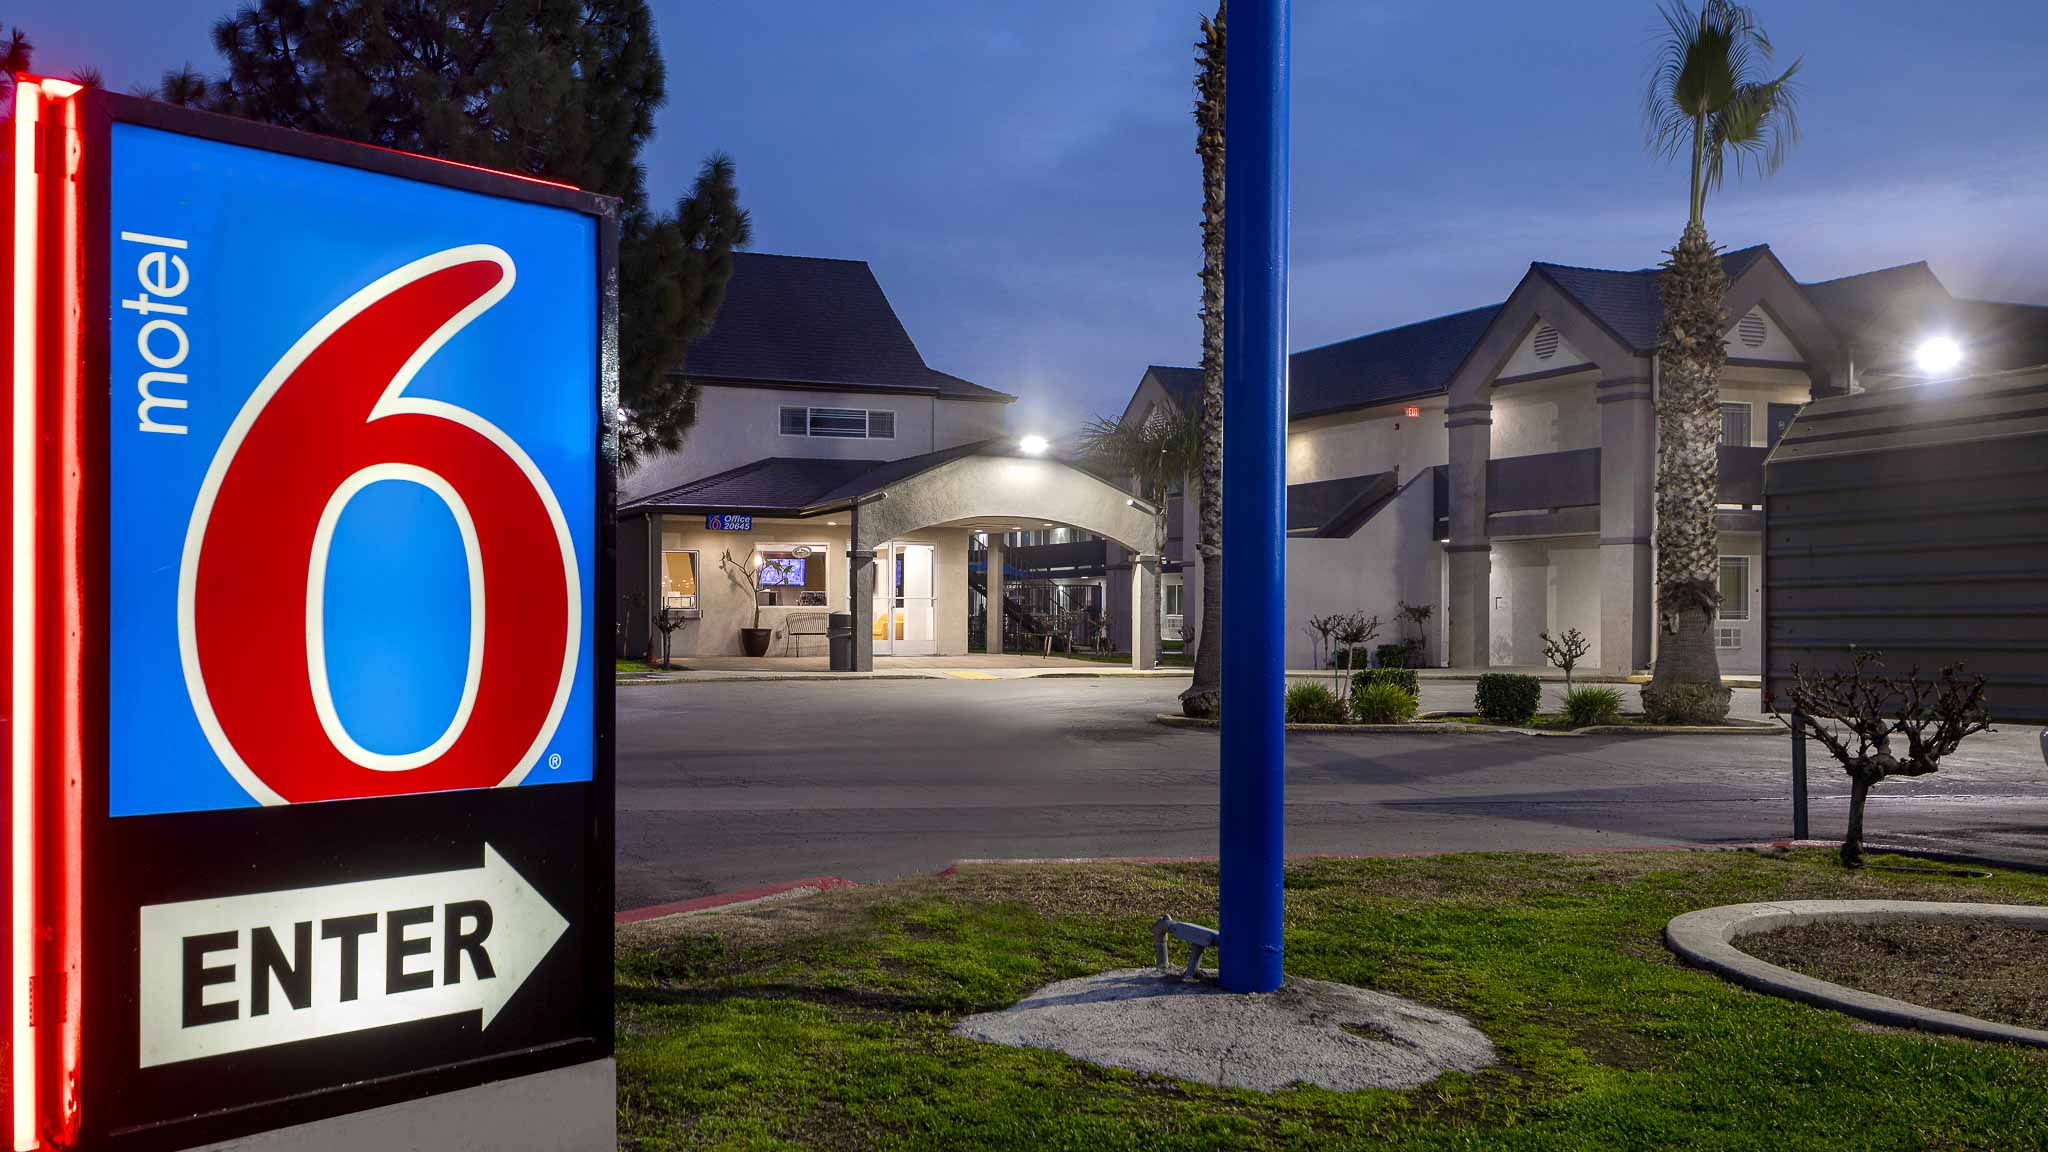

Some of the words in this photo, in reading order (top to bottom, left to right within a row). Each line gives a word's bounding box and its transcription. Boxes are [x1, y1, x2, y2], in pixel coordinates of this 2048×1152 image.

[121, 231, 190, 435] motel
[177, 244, 582, 805] 6
[710, 515, 721, 530] 6
[724, 515, 751, 523] Office
[182, 899, 497, 1029] ENTER
